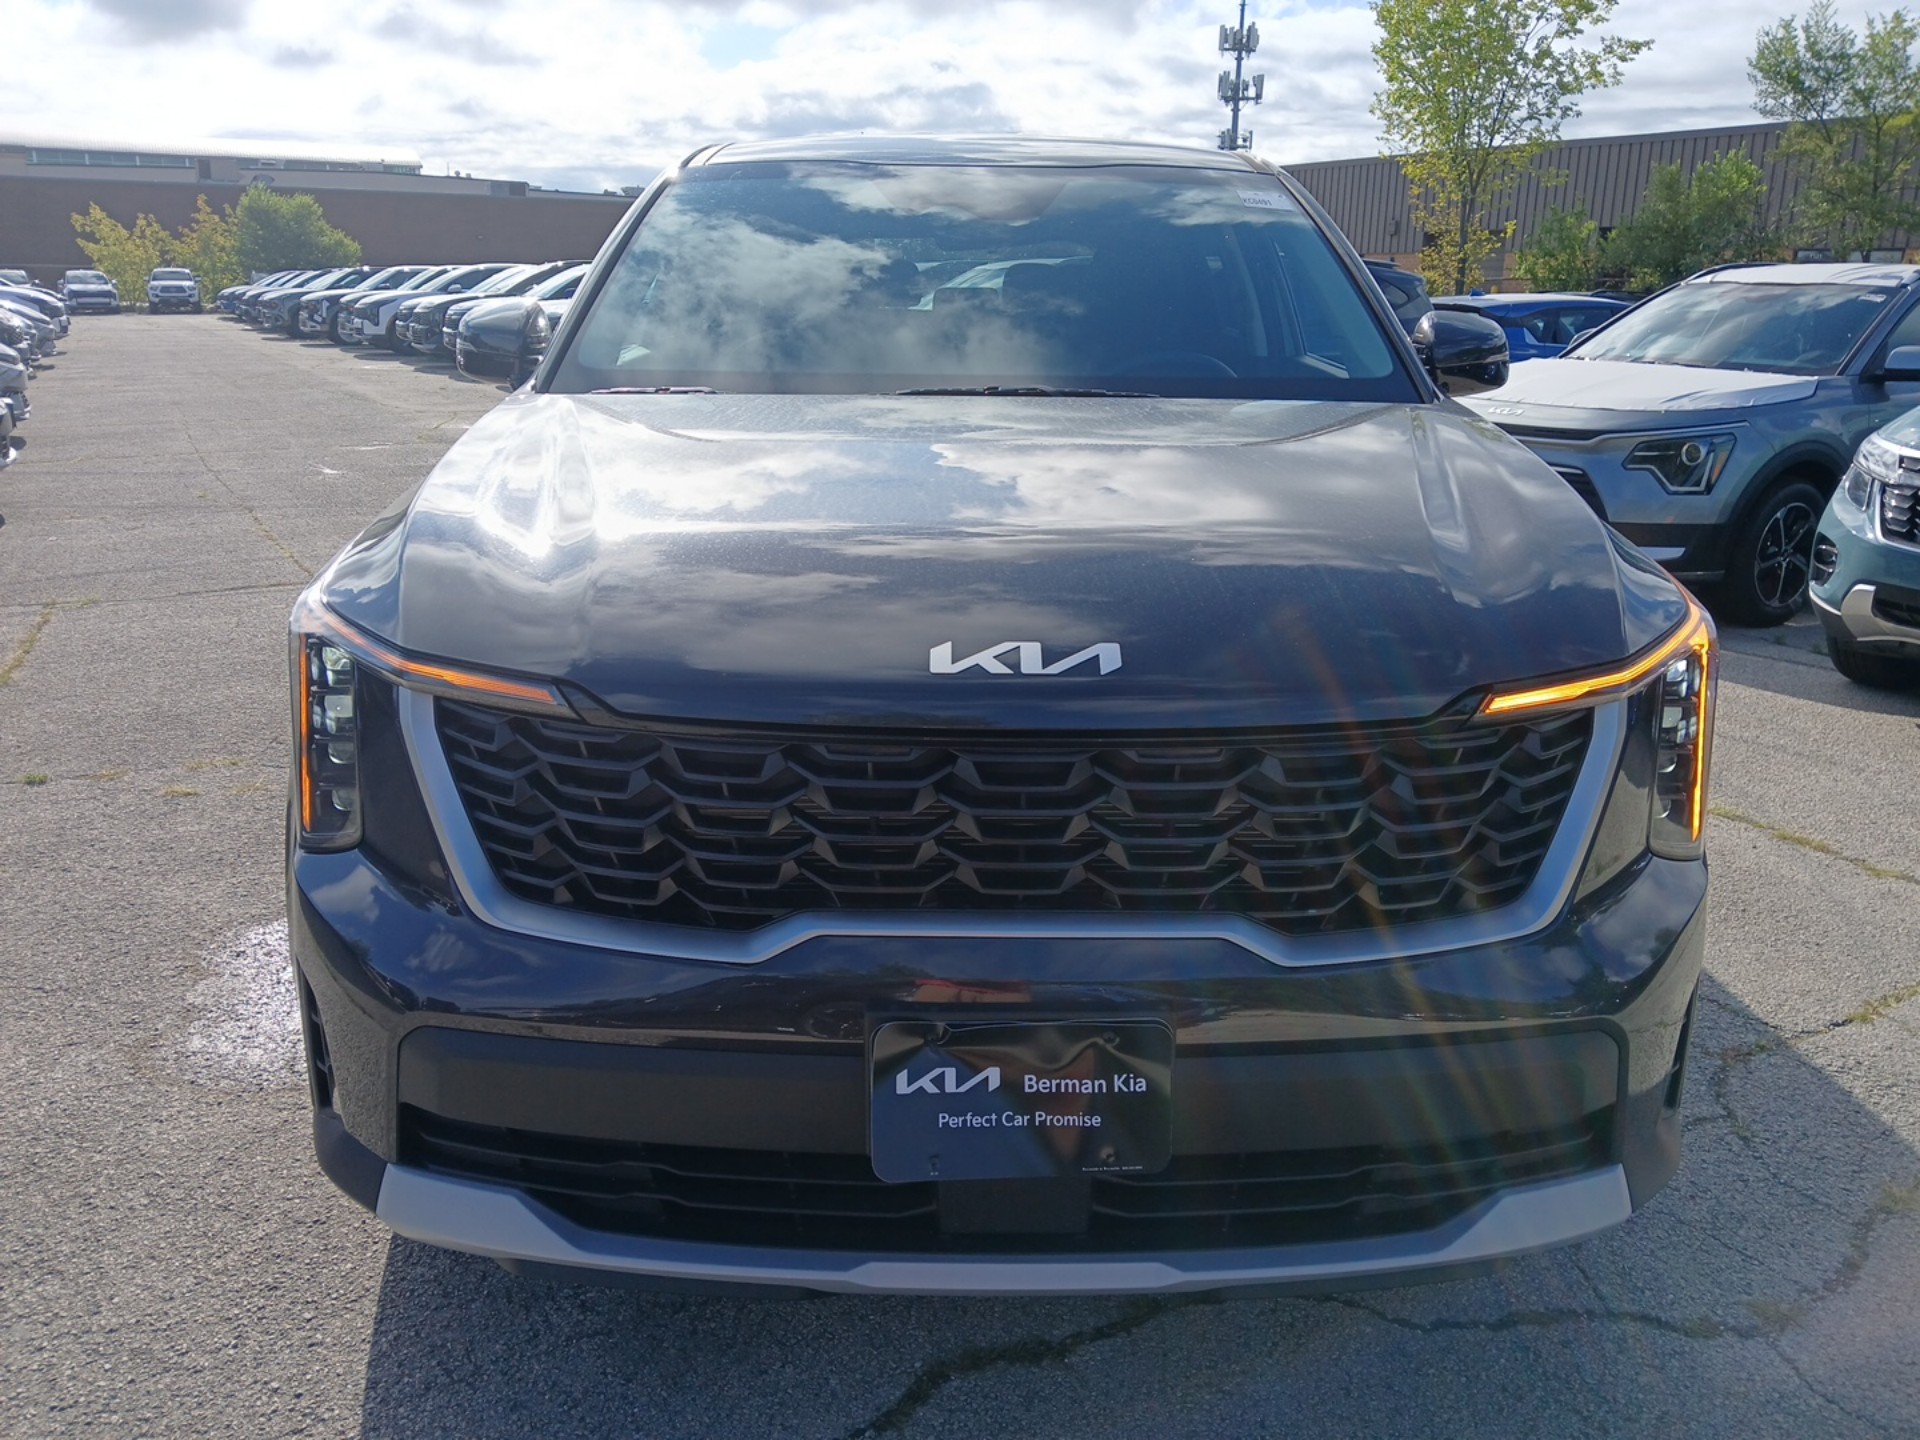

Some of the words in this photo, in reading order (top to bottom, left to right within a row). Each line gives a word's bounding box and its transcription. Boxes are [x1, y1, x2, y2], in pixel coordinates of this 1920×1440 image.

[929, 640, 1122, 676] KIA
[896, 1066, 1001, 1094] KIA
[1024, 1074, 1107, 1093] Berman
[1113, 1073, 1147, 1092] Kia
[938, 1112, 997, 1128] Perfect
[1001, 1111, 1031, 1126] Car
[1035, 1111, 1102, 1127] Promise
